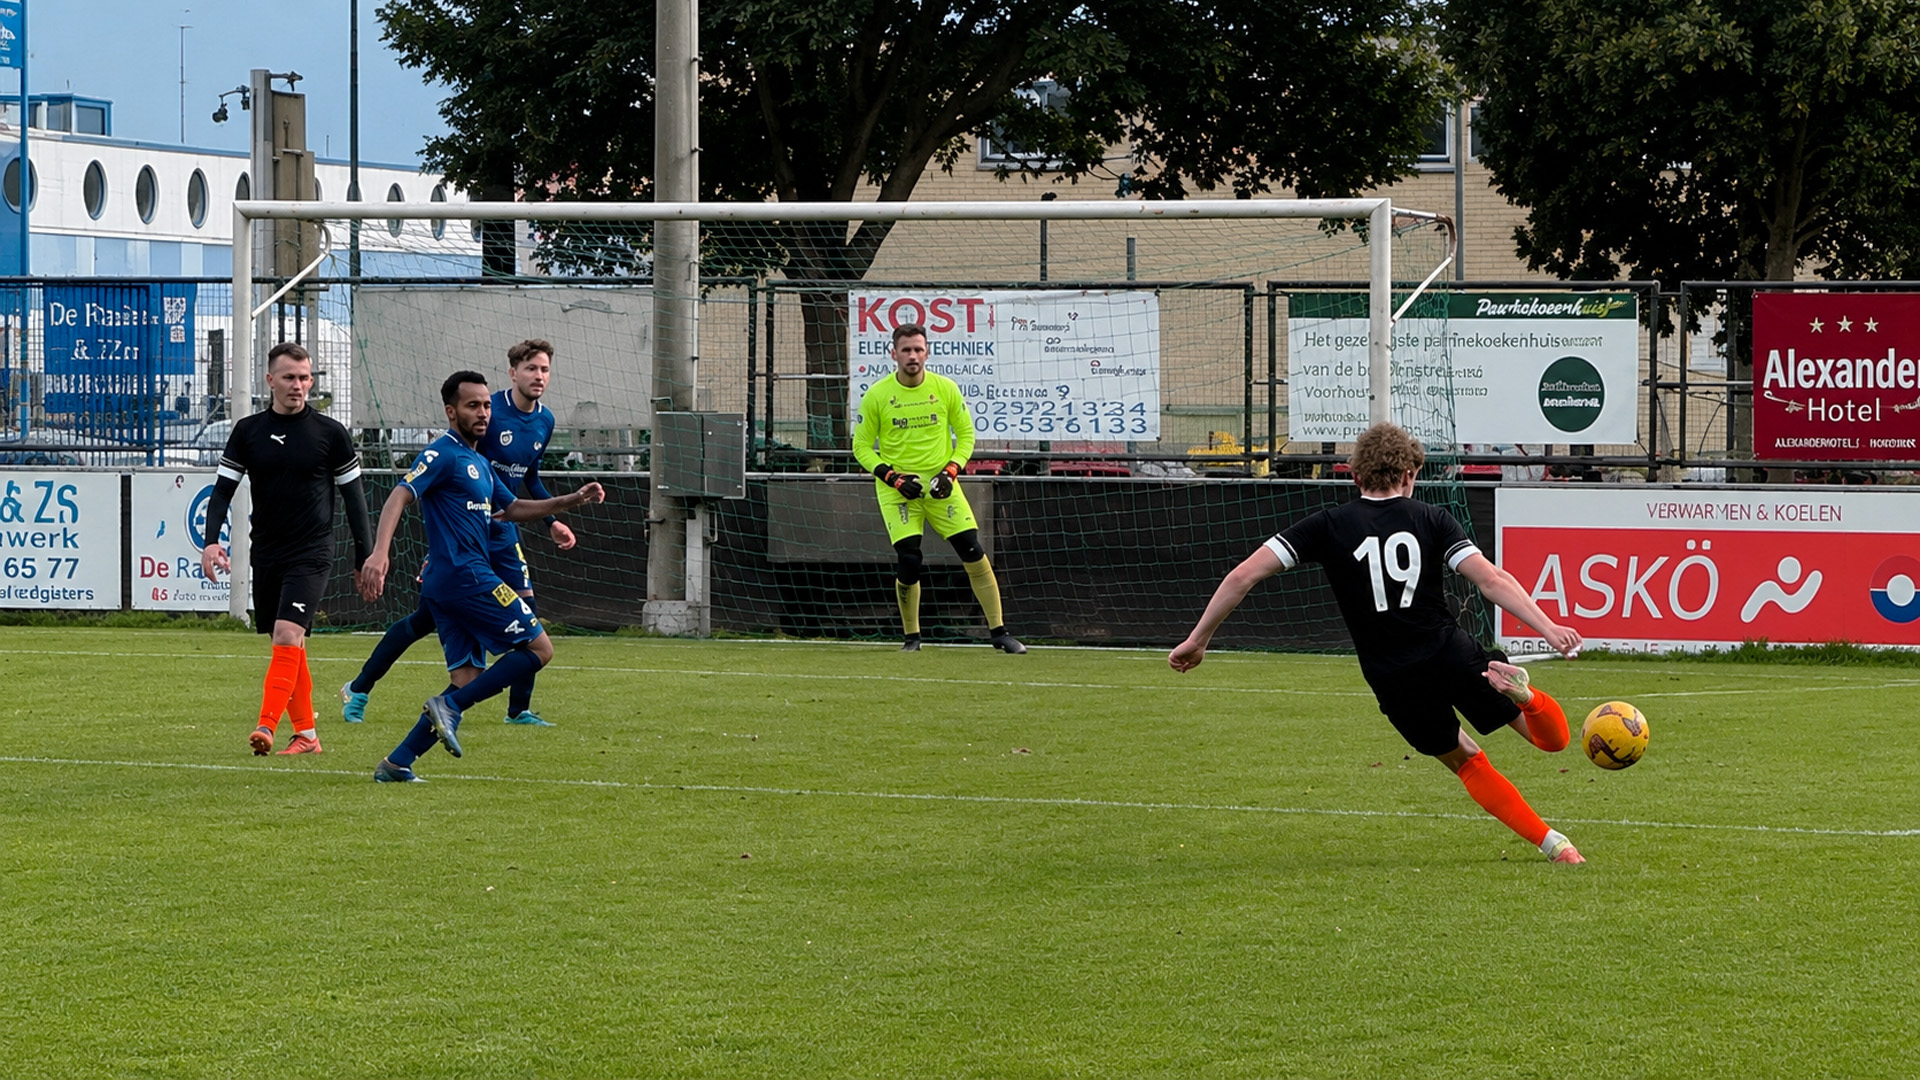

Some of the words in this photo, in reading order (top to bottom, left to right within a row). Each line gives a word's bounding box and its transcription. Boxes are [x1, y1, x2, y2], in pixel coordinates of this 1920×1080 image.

[1304, 332, 1331, 347] Het
[1302, 365, 1330, 377] van
[1334, 361, 1353, 377] de
[1763, 348, 1920, 389] Alexande
[1808, 397, 1881, 422] Hotel
[1647, 503, 1751, 521] VERWARMEN
[1756, 505, 1770, 521] &
[1774, 504, 1842, 521] KOELEN
[4, 557, 37, 579] 65
[48, 557, 79, 579] 77
[140, 556, 169, 578] De
[1353, 531, 1422, 612] 19
[1531, 540, 1719, 620] ASKÖ
